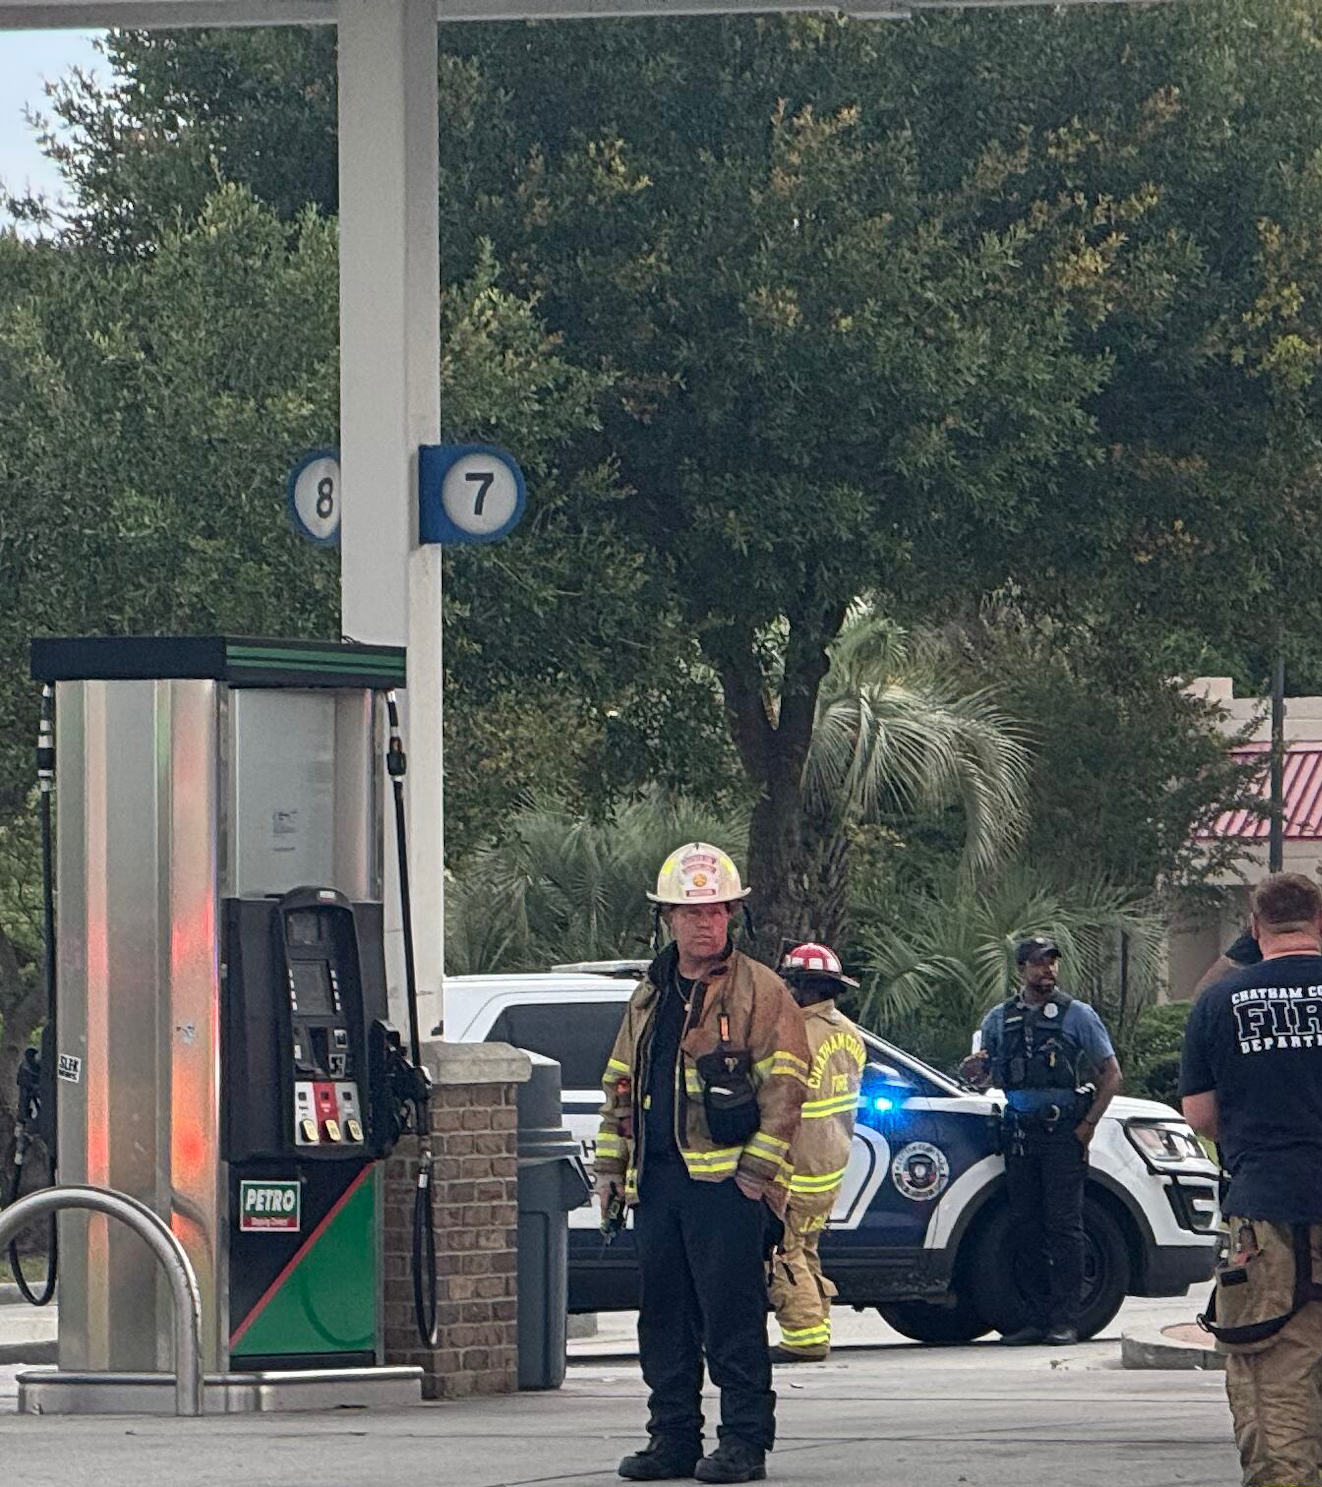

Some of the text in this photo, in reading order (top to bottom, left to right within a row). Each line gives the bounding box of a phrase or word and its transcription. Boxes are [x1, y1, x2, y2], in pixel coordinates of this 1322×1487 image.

[316, 477, 333, 519] 8
[465, 472, 495, 515] 7
[1231, 987, 1303, 1005] CHATHAM
[245, 1188, 296, 1212] PETRO
